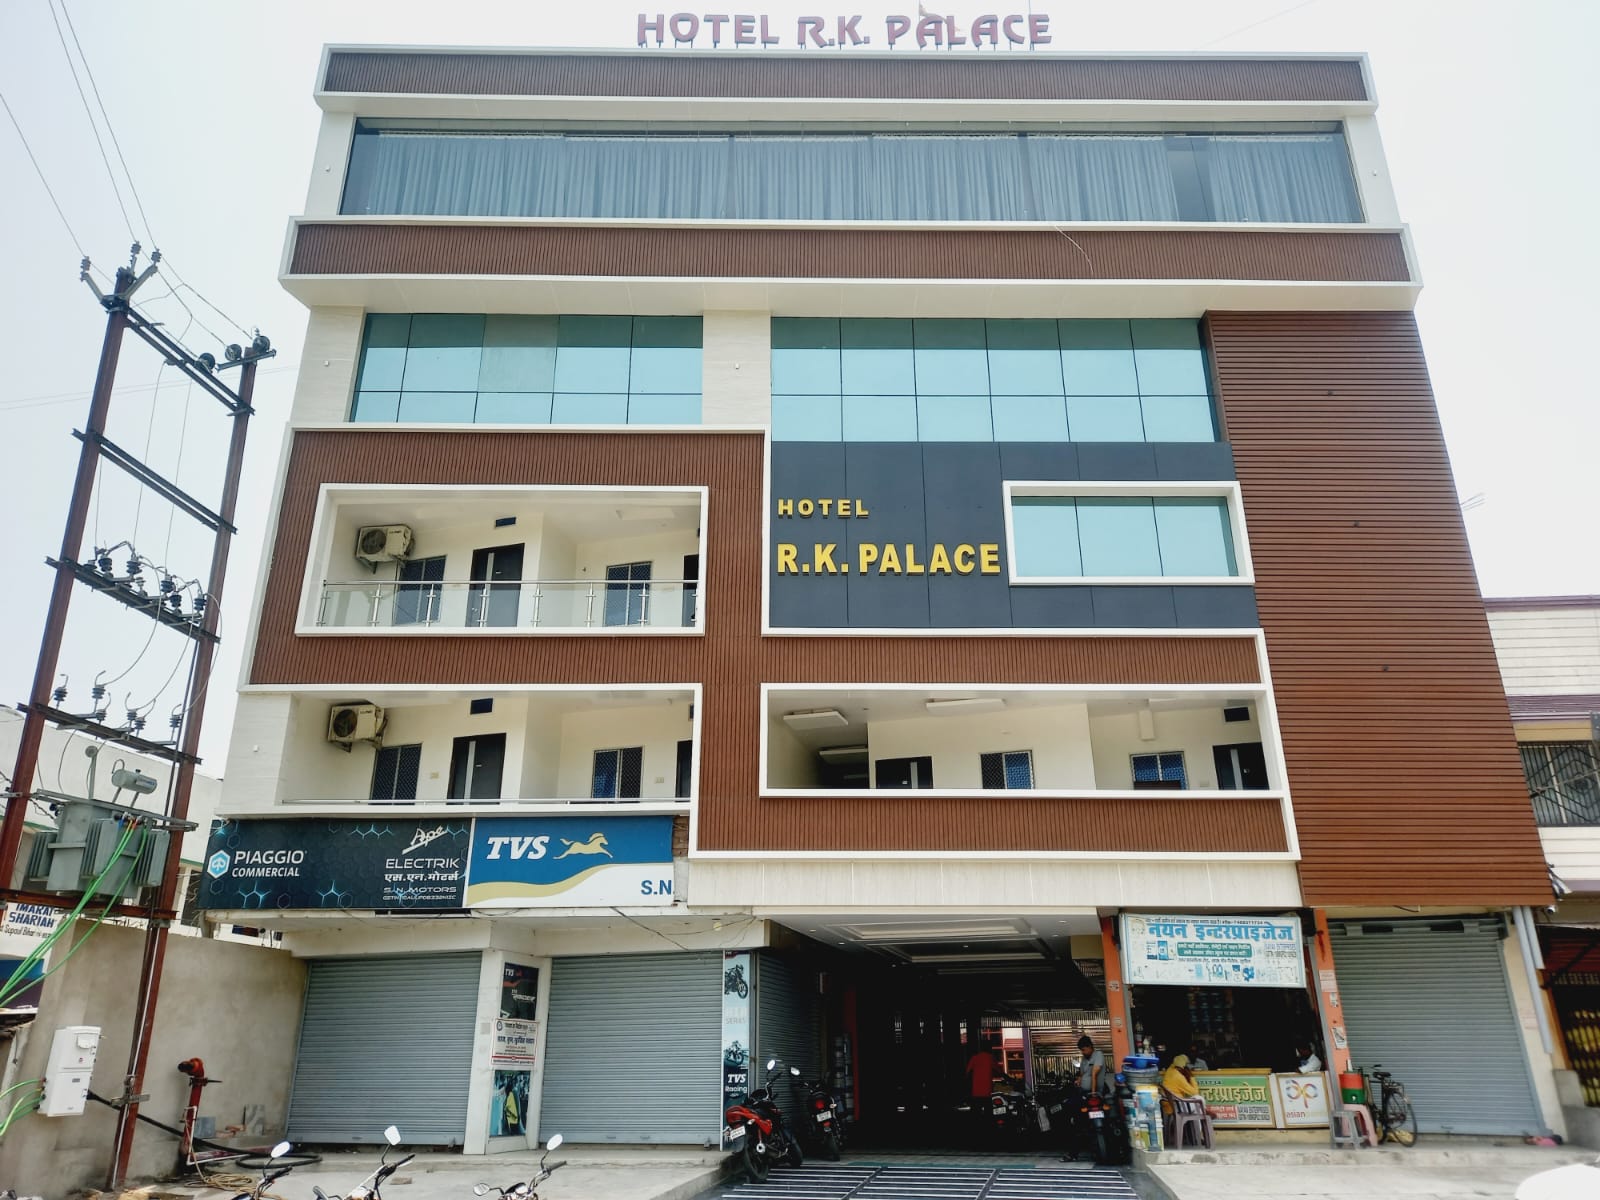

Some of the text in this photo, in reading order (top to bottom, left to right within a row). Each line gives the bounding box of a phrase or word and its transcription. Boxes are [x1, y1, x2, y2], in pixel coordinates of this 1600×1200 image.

[637, 13, 1052, 47] HOTEL R.K. PALACE
[777, 498, 869, 518] HOTEL
[776, 543, 1001, 576] R.K. PALACE
[486, 835, 550, 860] TVS
[233, 850, 305, 865] PIAGGIO
[385, 858, 460, 869] ELECTRIK
[231, 867, 300, 878] COMMERCIAL
[9, 911, 55, 929] SHARIAH
[1146, 923, 1187, 939] नयन
[727, 1073, 747, 1084] TVS
